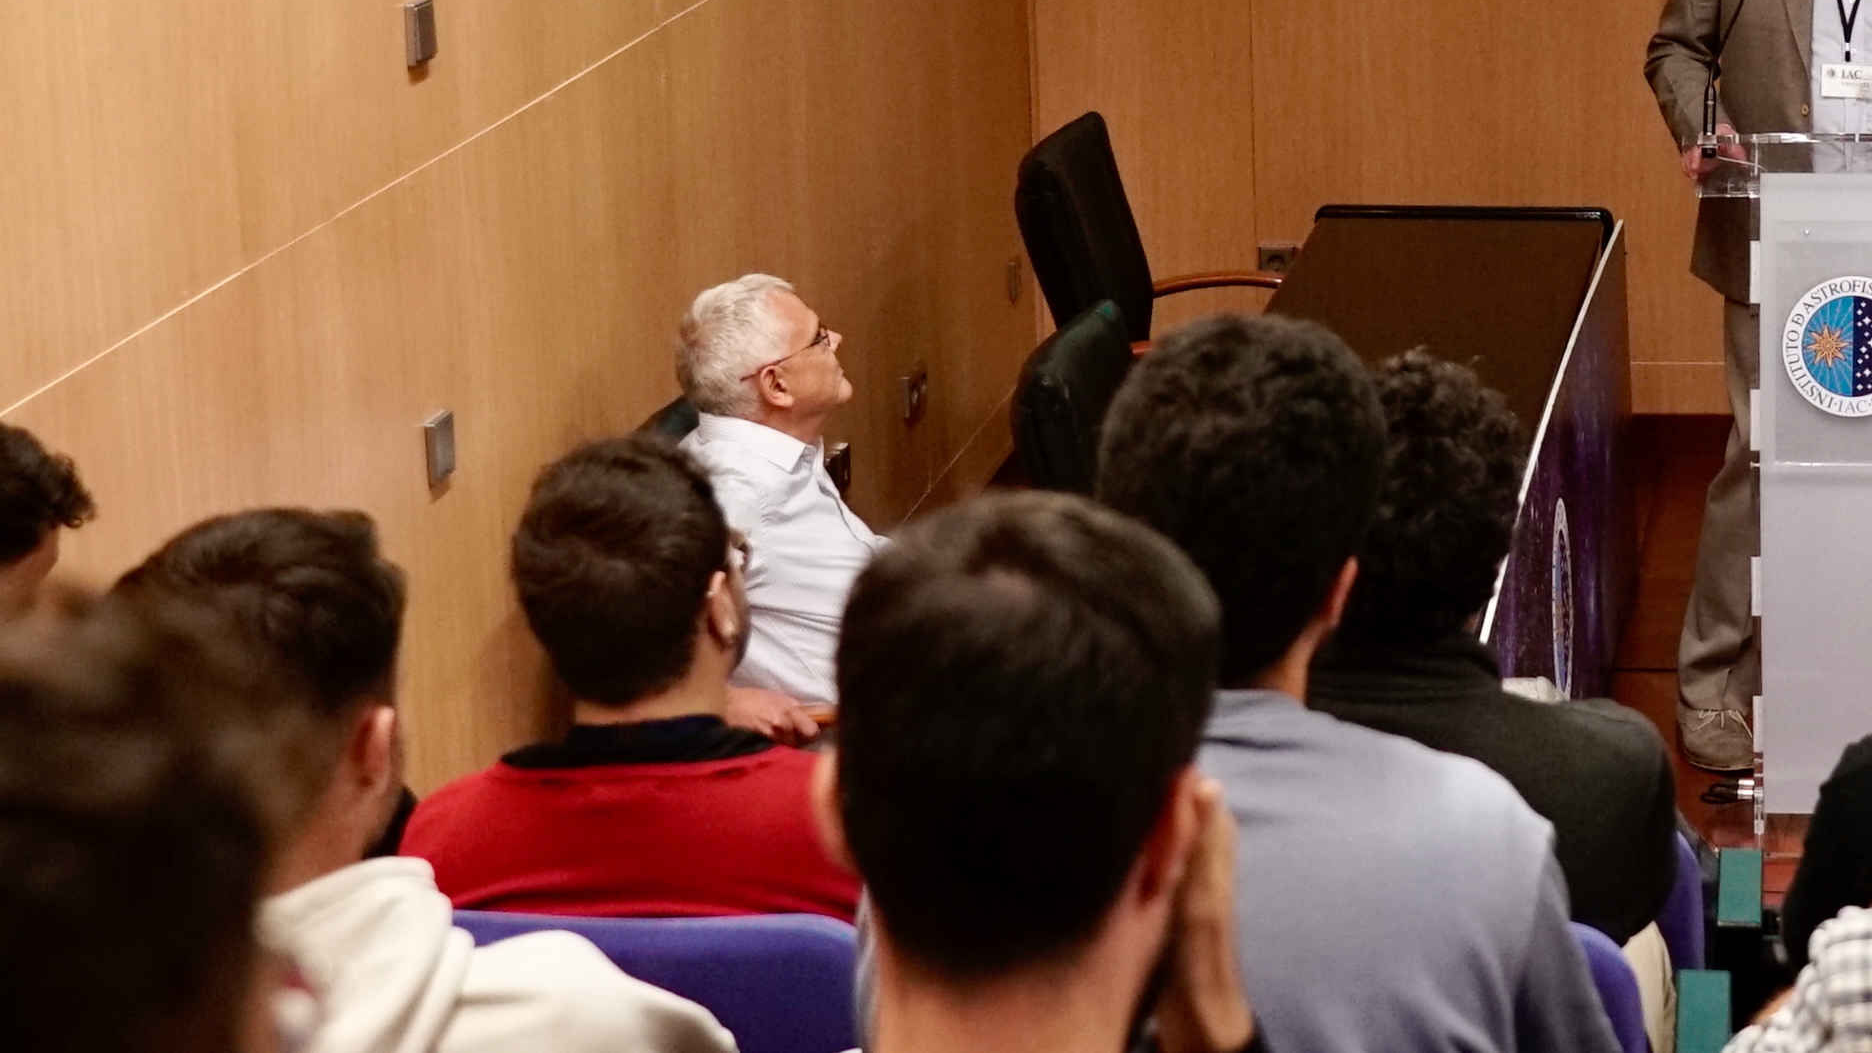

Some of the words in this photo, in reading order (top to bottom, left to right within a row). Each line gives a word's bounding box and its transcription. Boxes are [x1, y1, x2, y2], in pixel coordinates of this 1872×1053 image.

[1842, 69, 1863, 79] IAC
[1786, 330, 1834, 409] INSTITUTO
[1838, 399, 1868, 414] IAC
